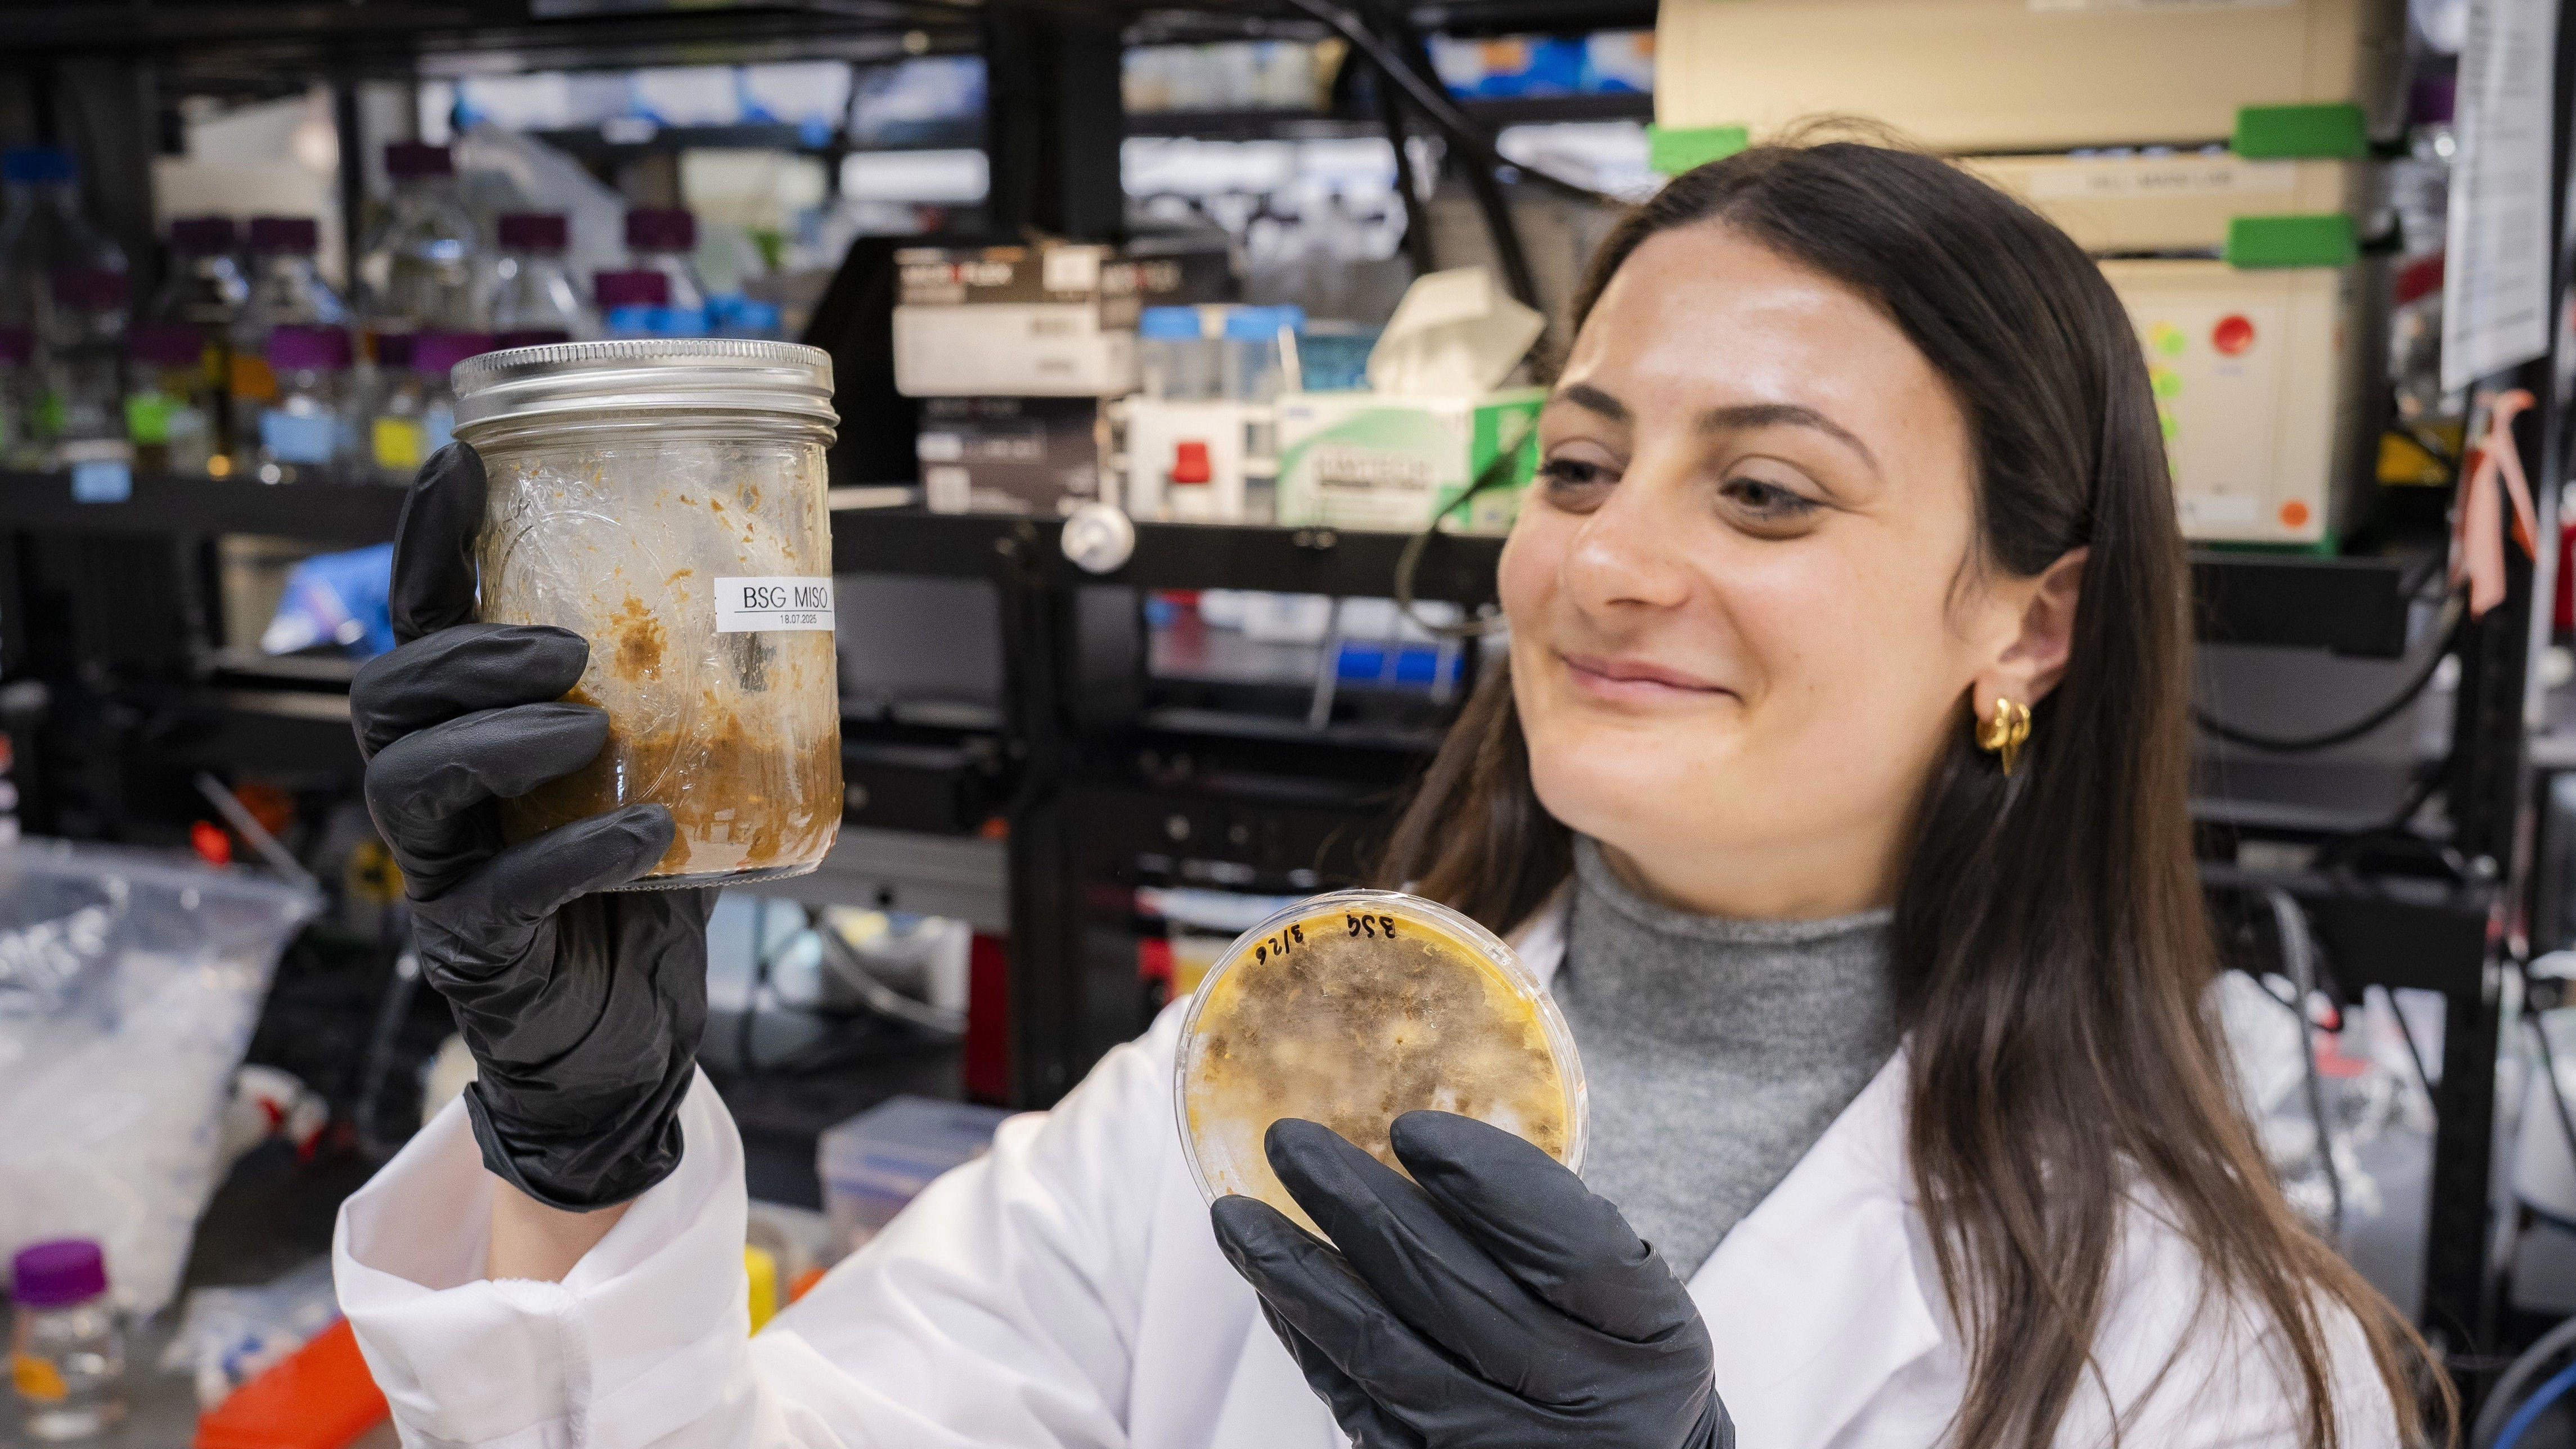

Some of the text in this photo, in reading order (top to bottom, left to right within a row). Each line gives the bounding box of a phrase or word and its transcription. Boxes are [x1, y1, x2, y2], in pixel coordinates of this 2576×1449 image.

[744, 587, 828, 608] BSG MISO
[780, 614, 817, 624] 18.07.2025
[1256, 914, 1396, 966] BSG 3/26
